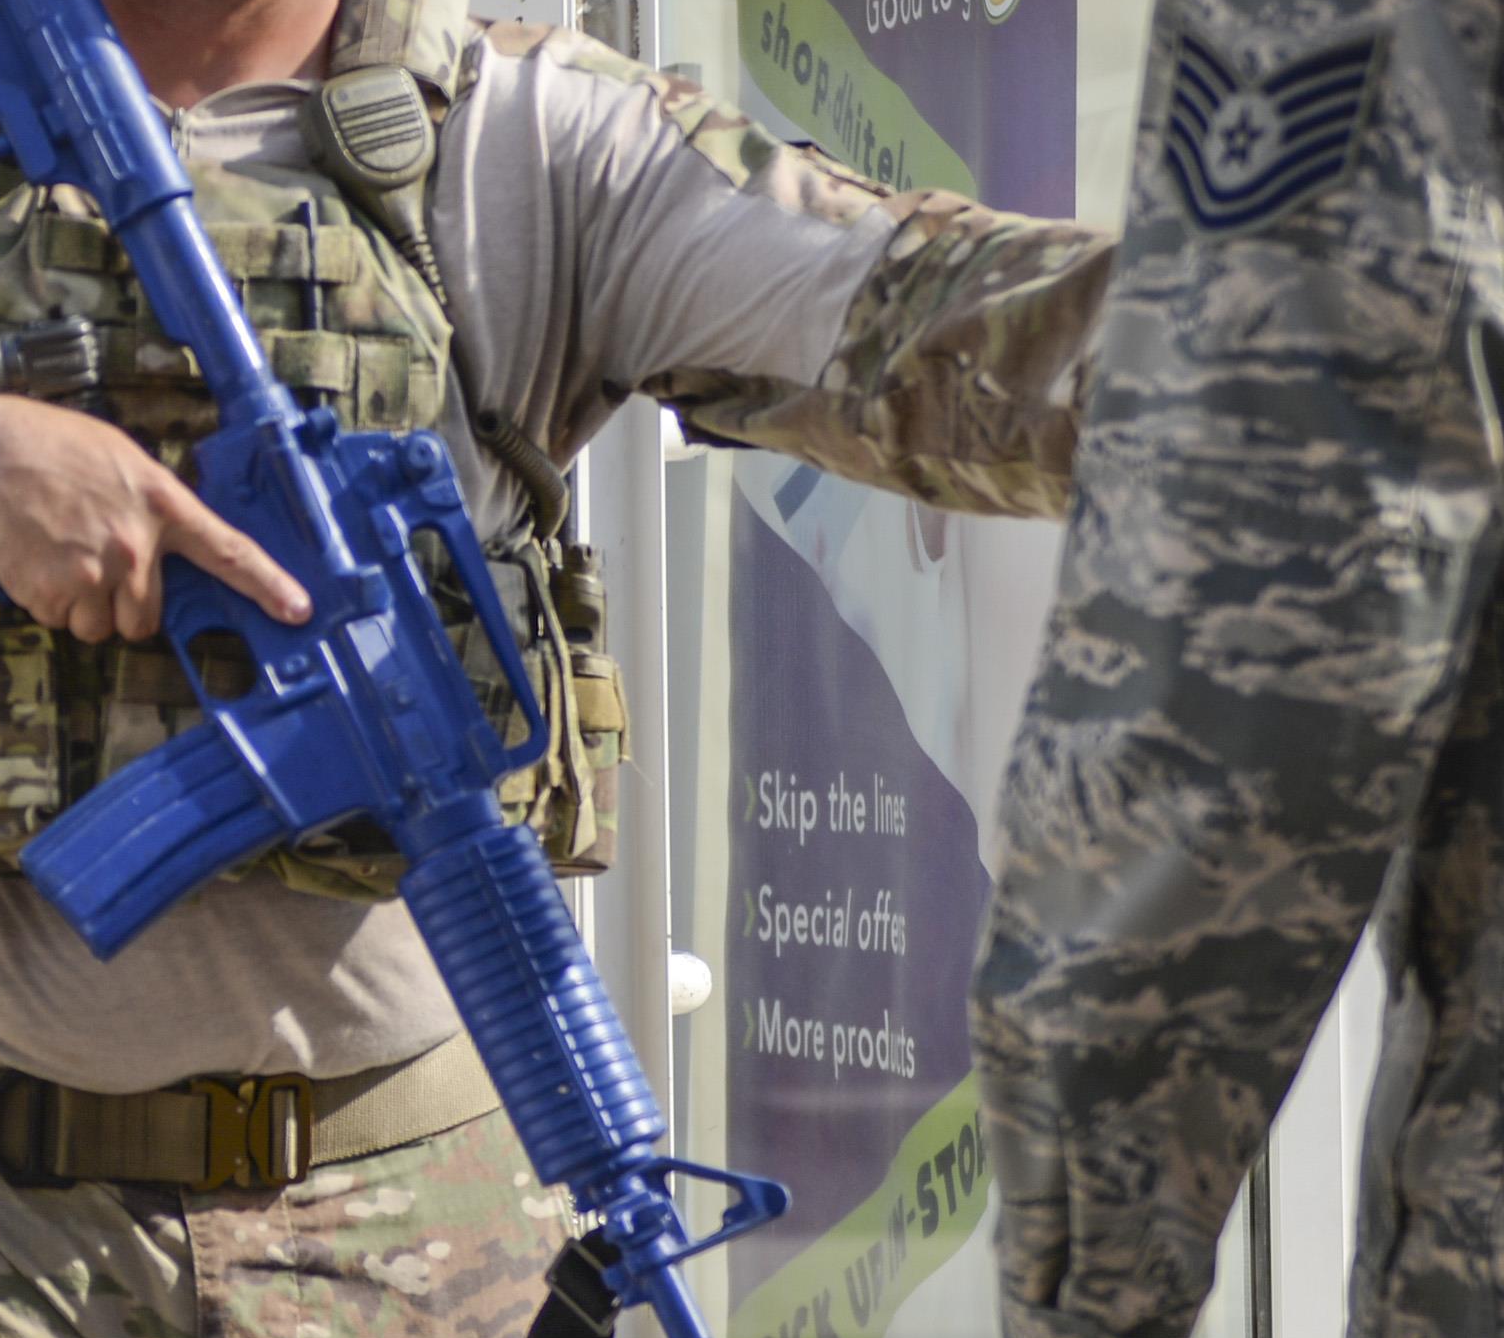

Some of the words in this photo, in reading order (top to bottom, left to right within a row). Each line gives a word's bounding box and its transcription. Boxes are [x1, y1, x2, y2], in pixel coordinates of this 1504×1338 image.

[759, 770, 818, 847] Skip
[828, 771, 867, 834] the
[758, 884, 853, 958] Special
[758, 998, 825, 1062] More
